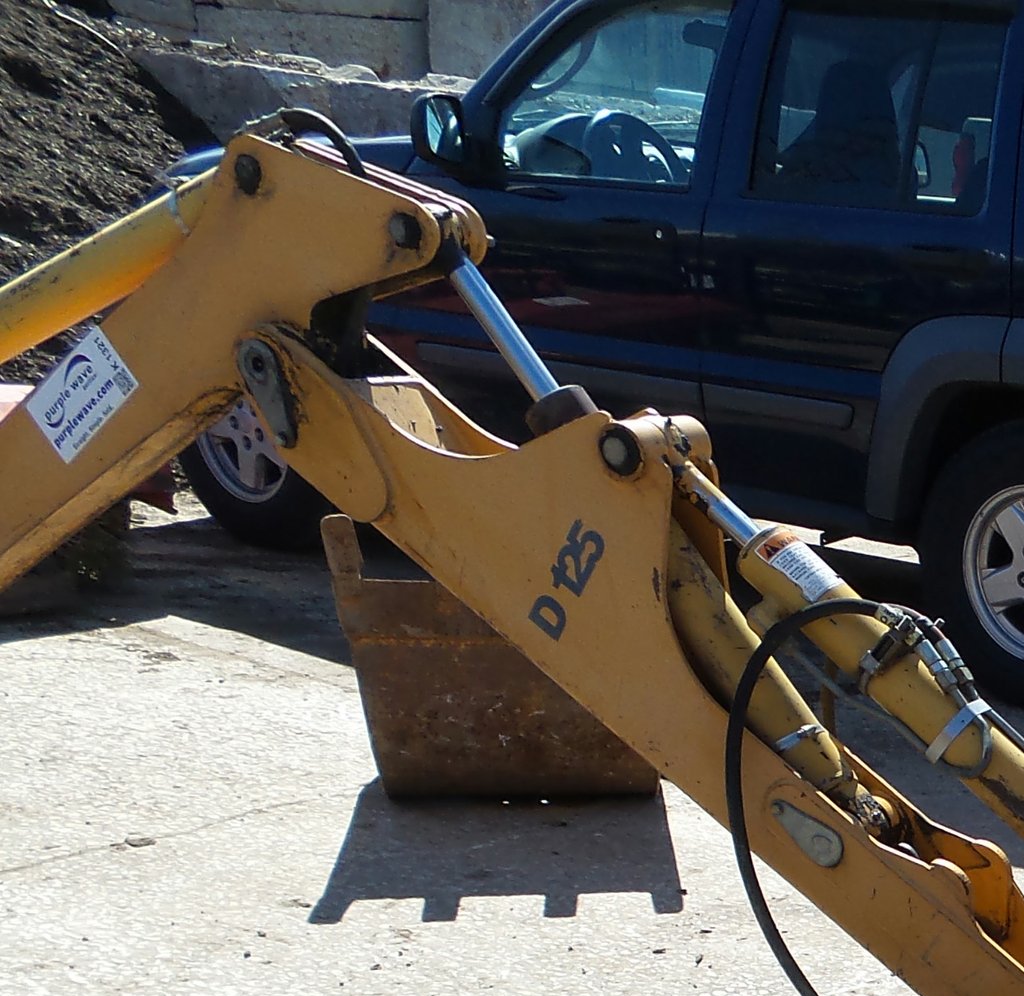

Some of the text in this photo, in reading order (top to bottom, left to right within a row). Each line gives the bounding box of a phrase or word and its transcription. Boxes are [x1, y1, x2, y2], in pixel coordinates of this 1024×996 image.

[44, 389, 71, 422] purple
[70, 365, 93, 390] wave
[53, 379, 114, 449] purplewave.com
[528, 518, 605, 642] D 125
